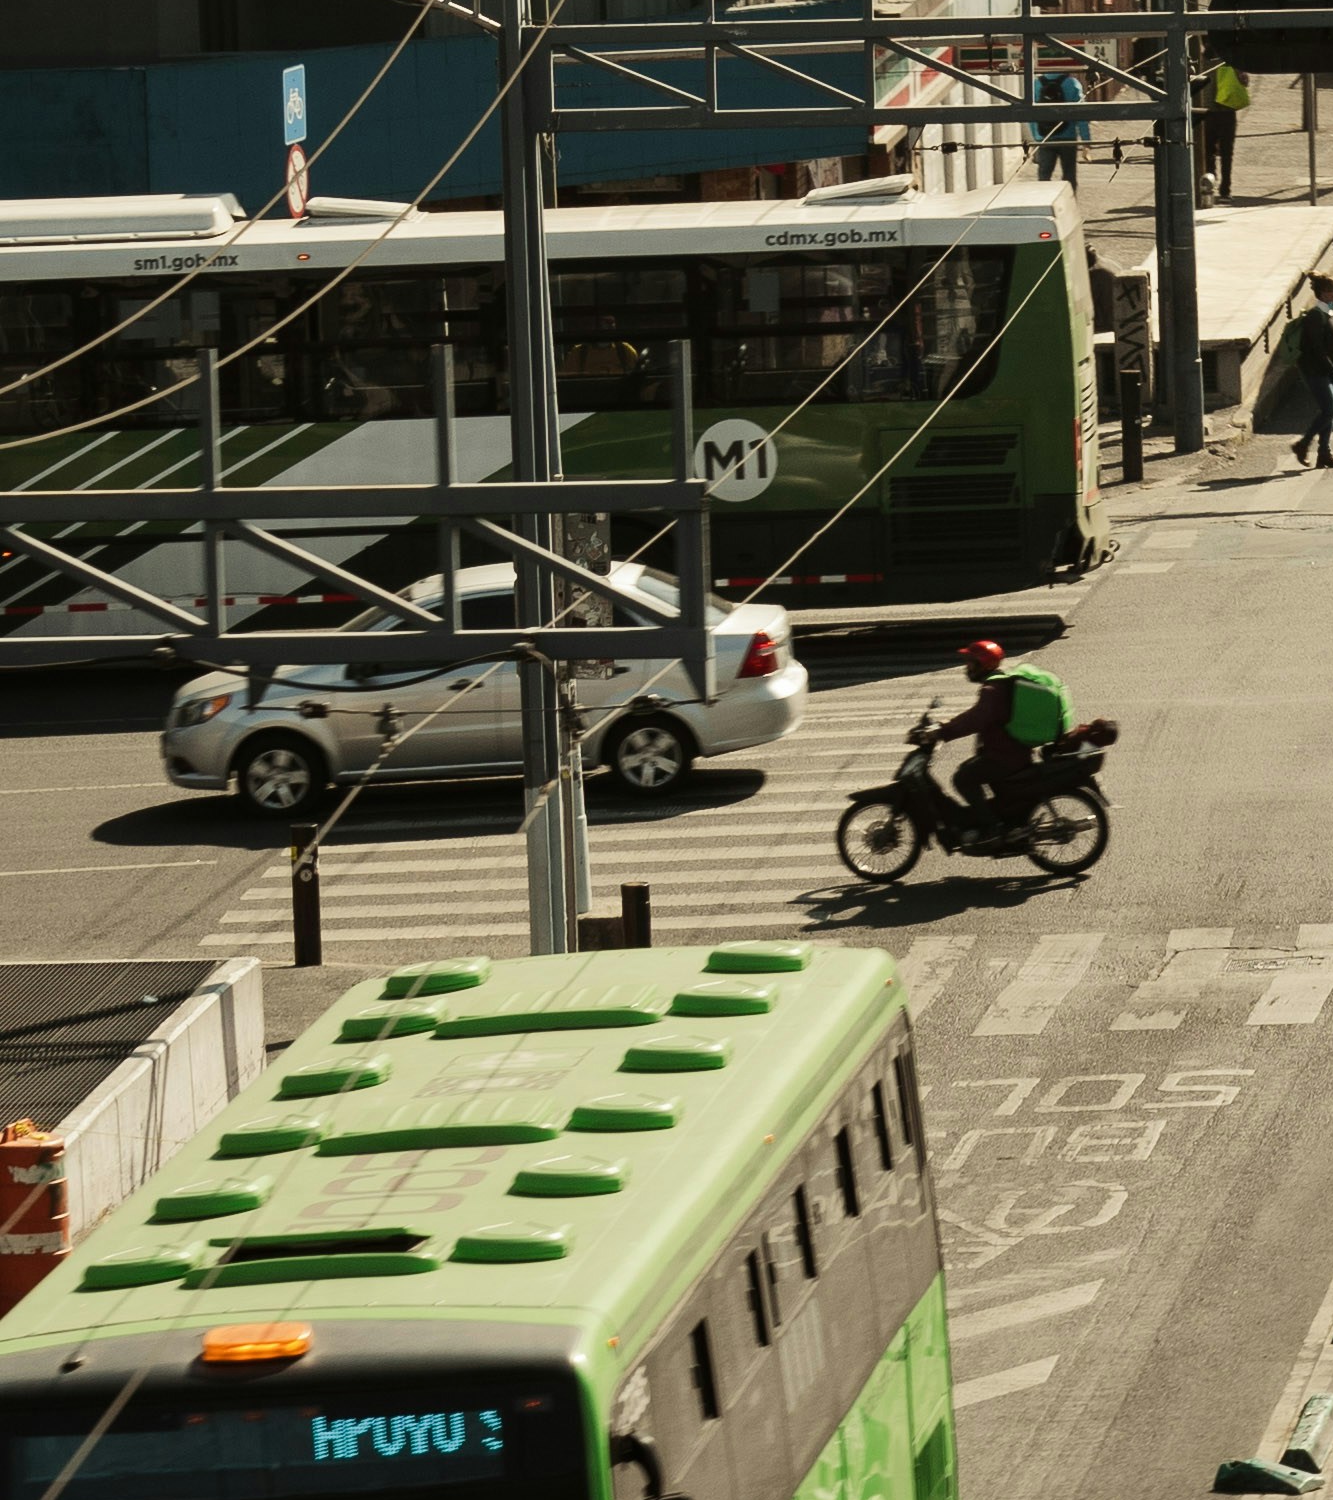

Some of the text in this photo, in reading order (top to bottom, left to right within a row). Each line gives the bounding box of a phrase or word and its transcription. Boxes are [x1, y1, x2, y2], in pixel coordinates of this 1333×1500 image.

[765, 229, 898, 247] cdmx.gob.mx
[134, 254, 239, 271] sm1.gob.mx
[703, 438, 769, 481] M1
[920, 1068, 1256, 1117] SOL
